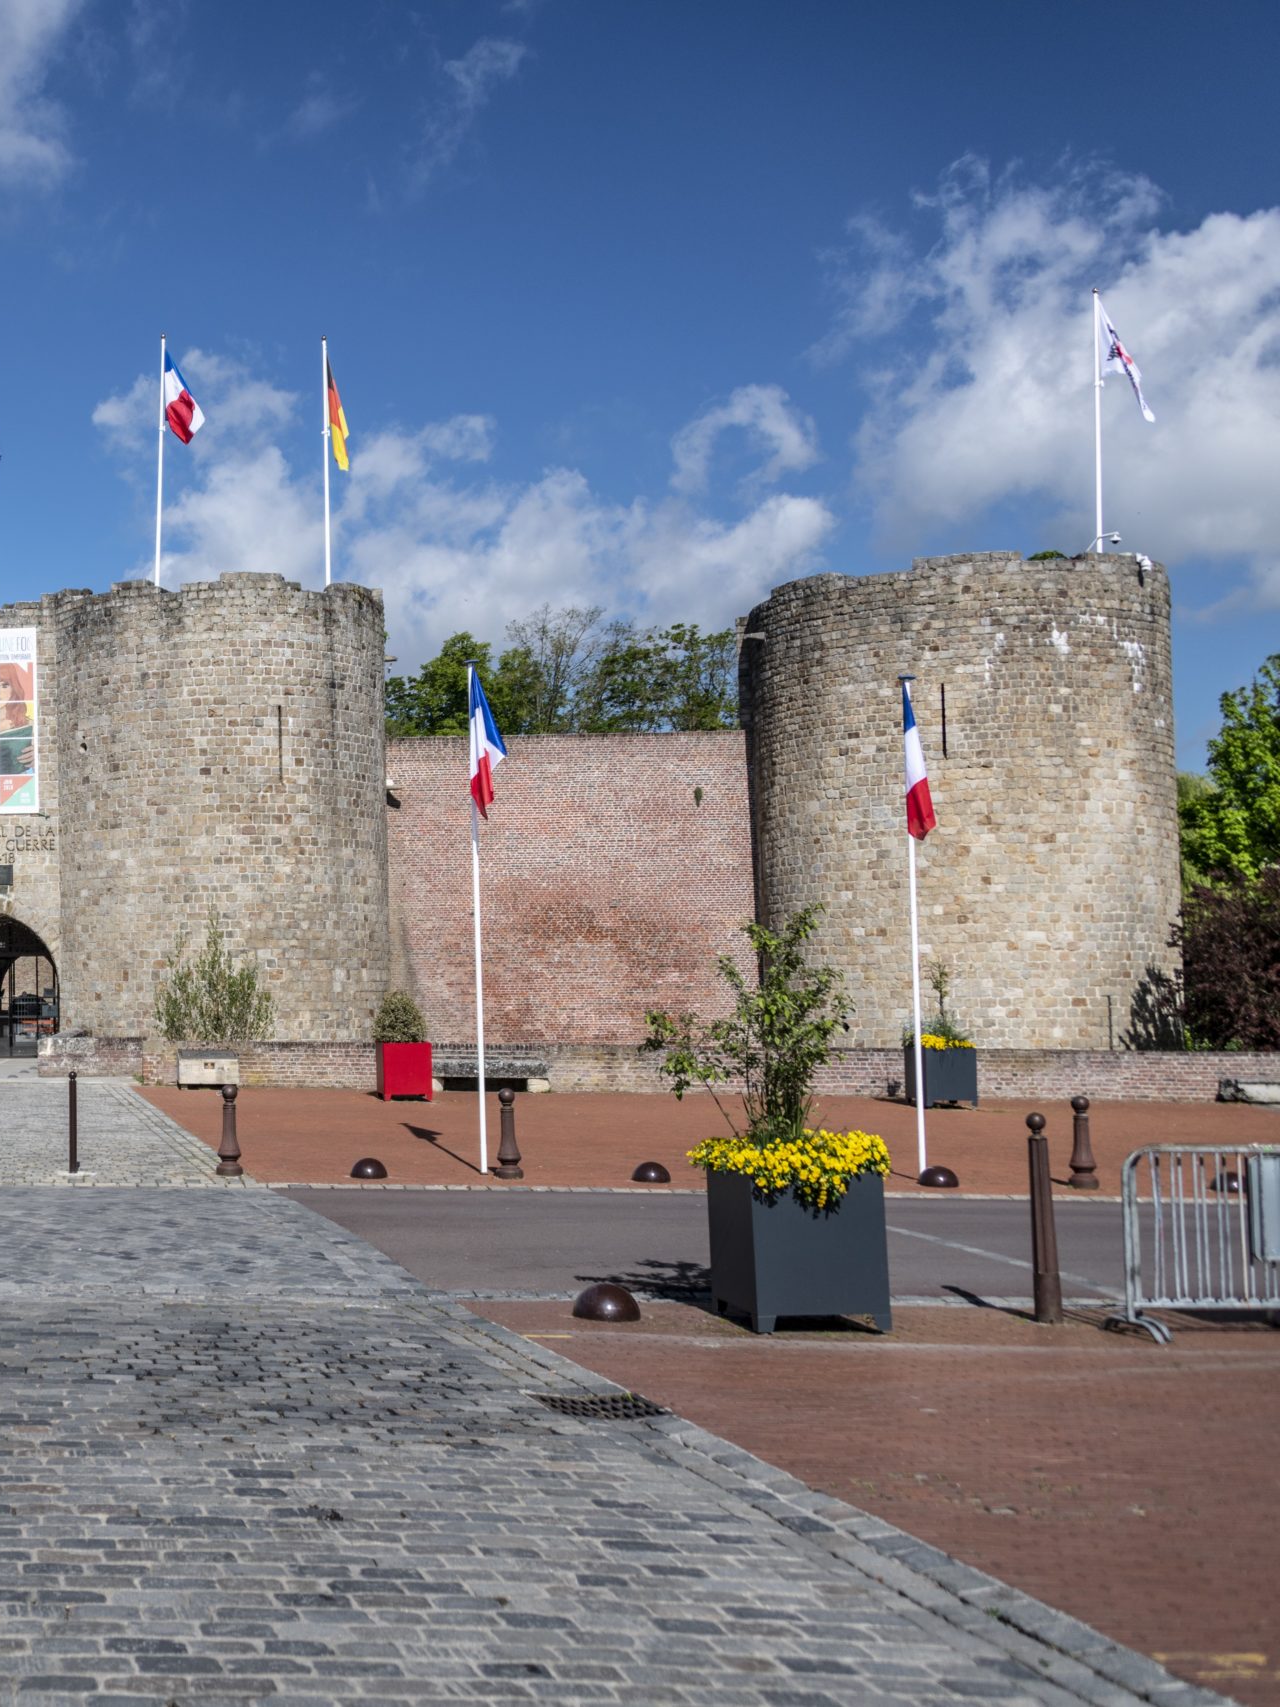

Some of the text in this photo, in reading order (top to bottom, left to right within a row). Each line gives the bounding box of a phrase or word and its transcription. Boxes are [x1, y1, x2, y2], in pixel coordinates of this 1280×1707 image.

[14, 825, 31, 838] DE
[38, 825, 56, 838] LA
[6, 839, 56, 852] GUERRE
